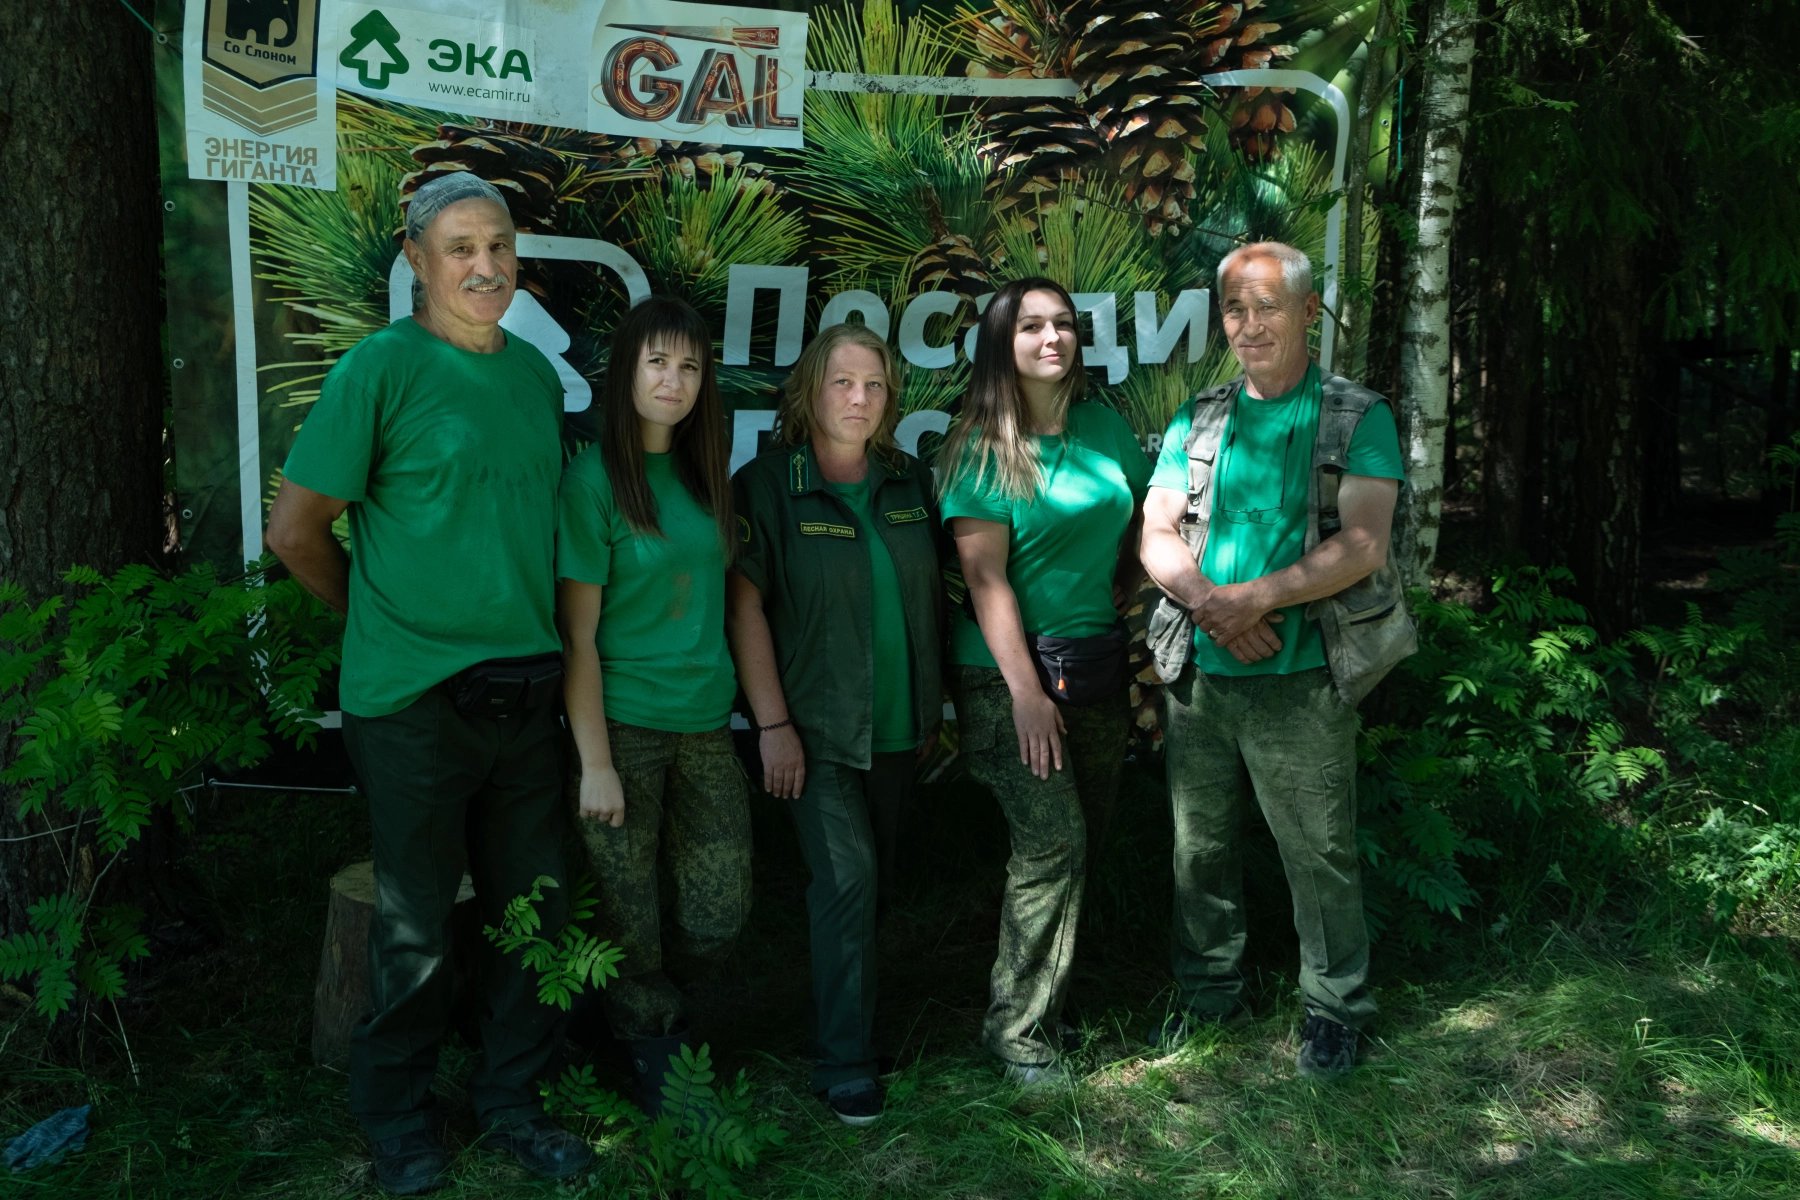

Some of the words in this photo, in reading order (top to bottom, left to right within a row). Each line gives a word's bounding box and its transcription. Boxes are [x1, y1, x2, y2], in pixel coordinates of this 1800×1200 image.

[224, 40, 240, 54] Со
[245, 45, 297, 65] Слоном
[427, 38, 533, 83] ЭКА
[428, 82, 530, 103] www.ecamir.ru
[601, 35, 800, 131] GAL
[205, 137, 318, 166] ЭНЕРГИЯ
[206, 158, 318, 186] ГИГАНТА
[722, 263, 1210, 386] Посди
[803, 525, 828, 533] ЛЕСНАЯ
[828, 527, 853, 536] ОХРАНА
